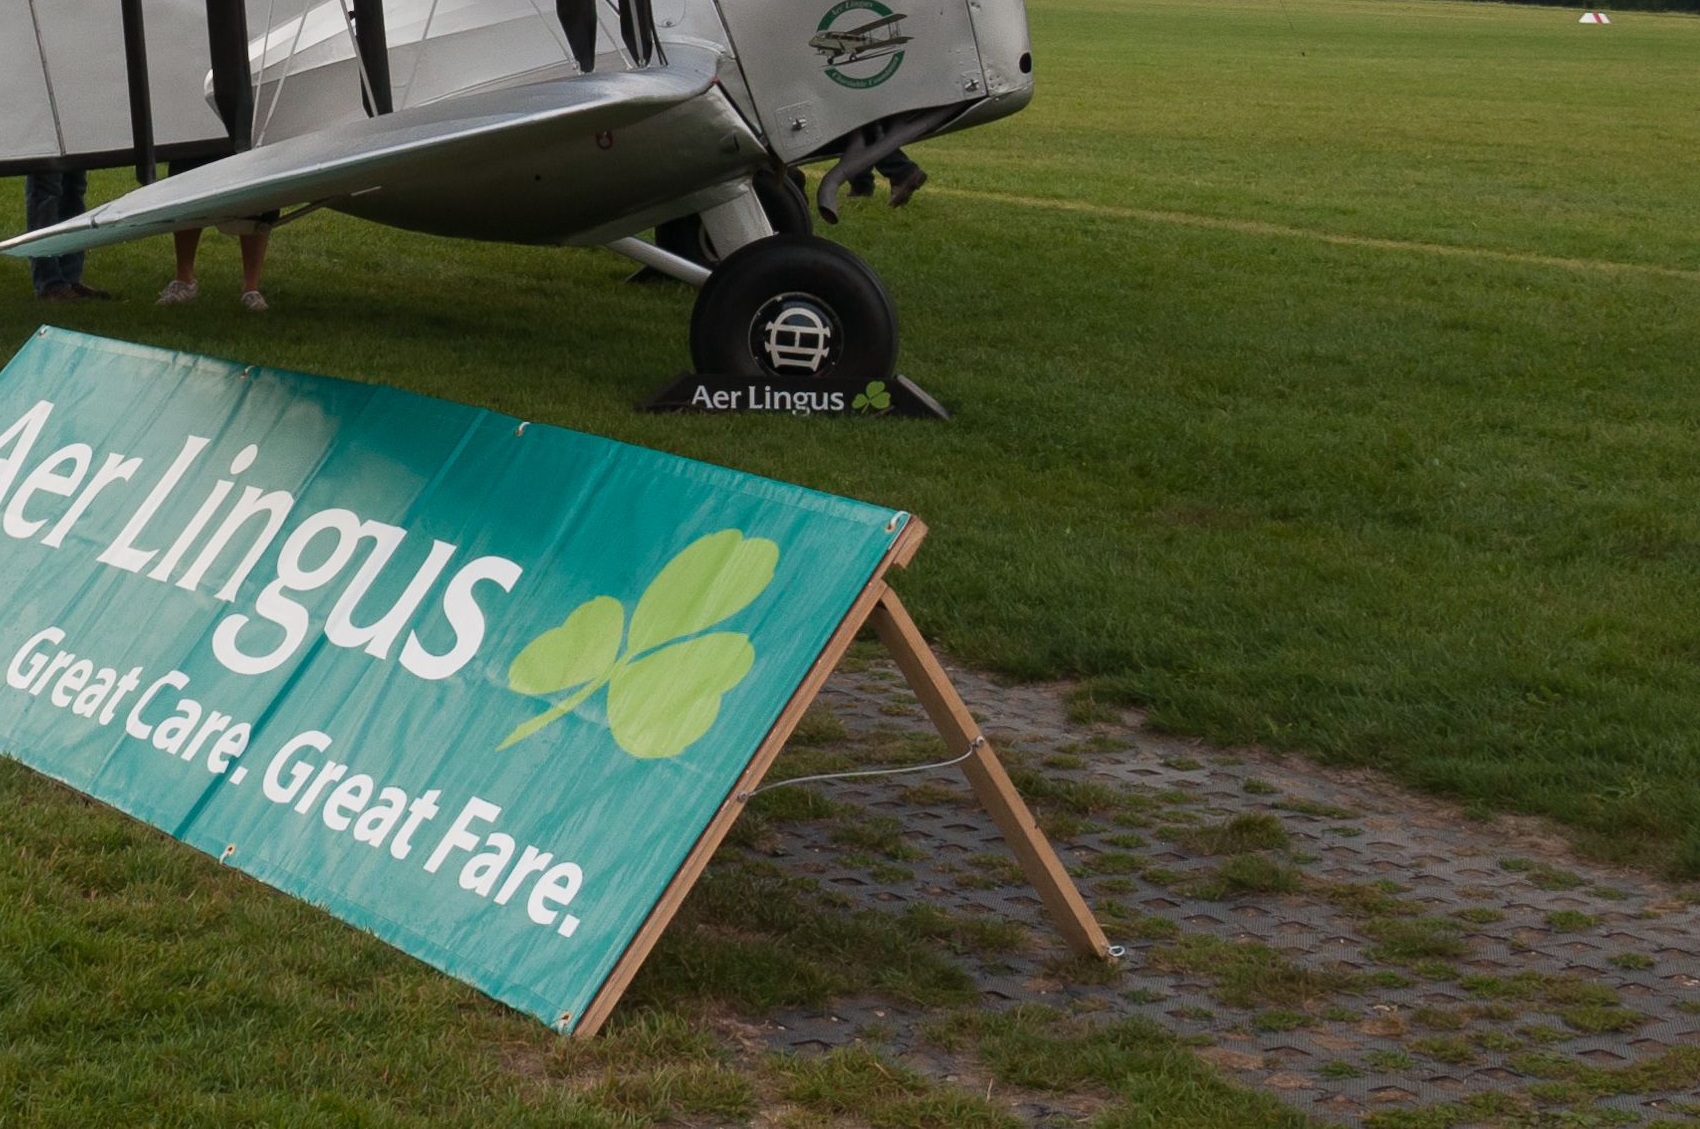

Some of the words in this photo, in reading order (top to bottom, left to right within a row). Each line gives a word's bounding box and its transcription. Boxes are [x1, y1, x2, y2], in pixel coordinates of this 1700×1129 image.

[691, 384, 742, 410] Aer
[748, 384, 846, 417] Lingus
[95, 433, 524, 681] Lingus
[5, 626, 144, 726] Great
[125, 669, 253, 785] Care.
[262, 729, 443, 861] Great
[422, 795, 584, 938] Fare.
